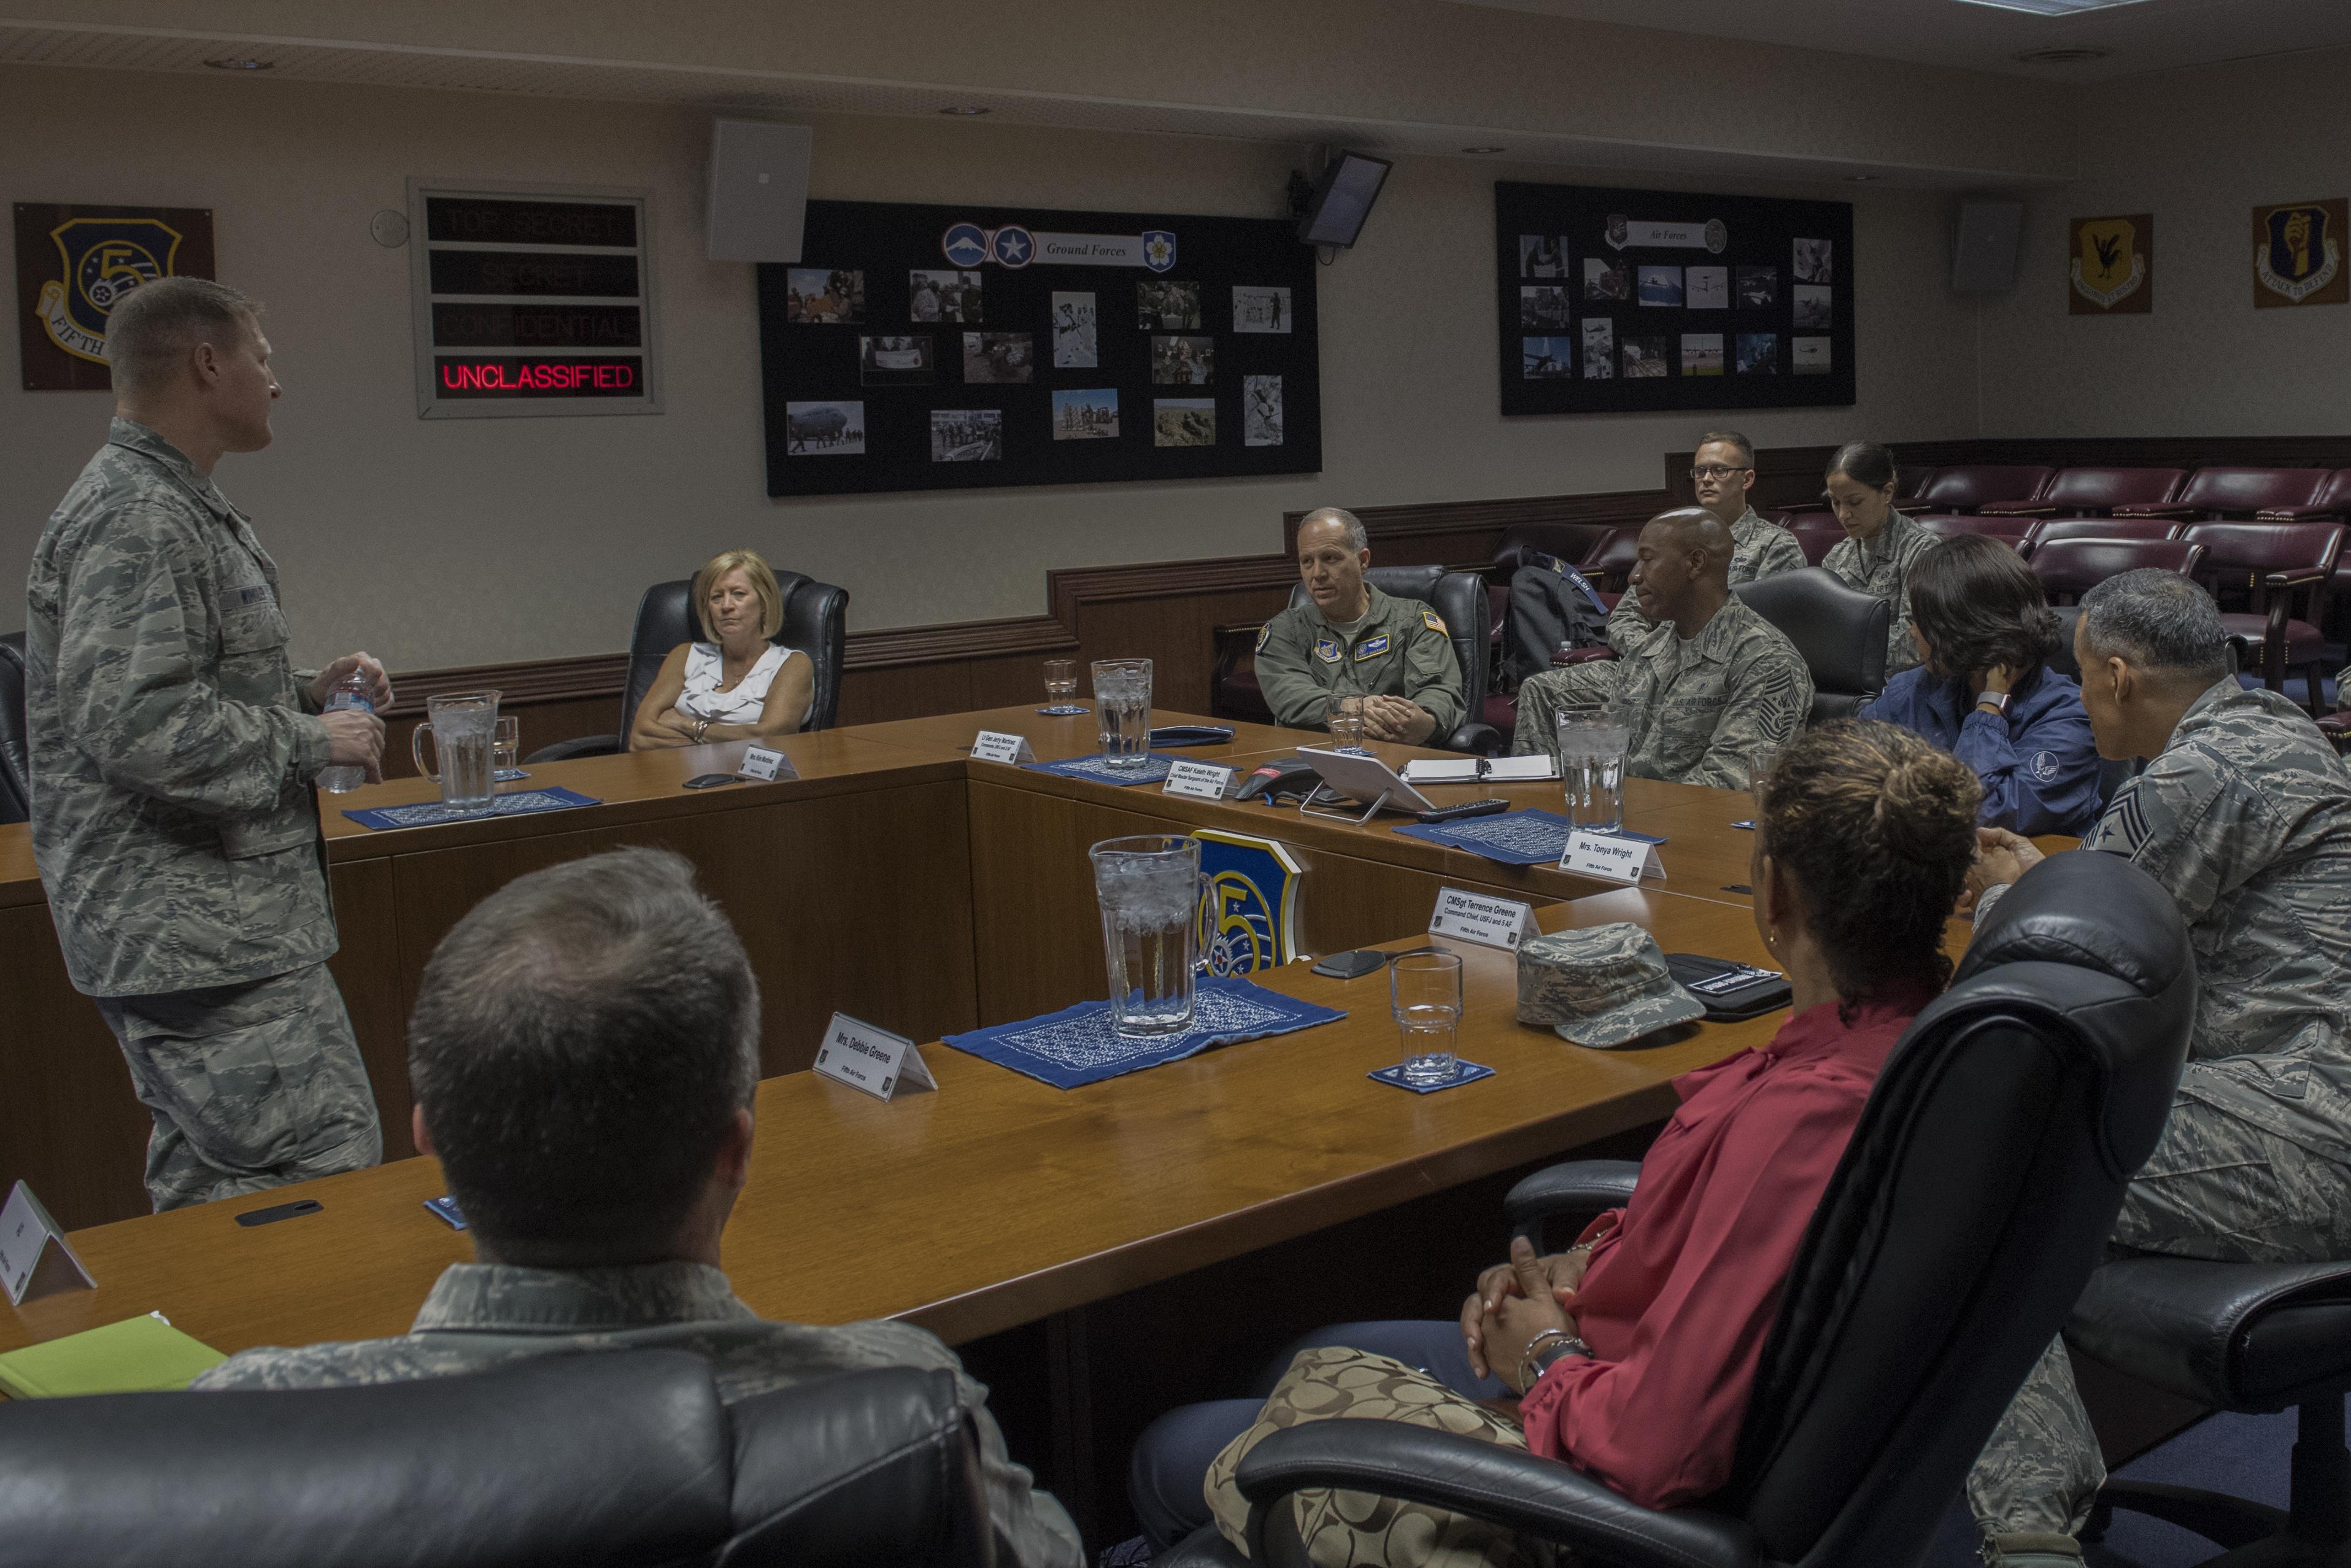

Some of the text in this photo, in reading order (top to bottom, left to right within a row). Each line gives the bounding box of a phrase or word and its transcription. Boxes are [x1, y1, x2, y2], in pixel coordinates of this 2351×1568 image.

[1650, 230, 1687, 240] Air Forces
[1047, 243, 1126, 256] Ground Forces
[2263, 264, 2333, 296] ATTACK TO DEFEND
[52, 316, 104, 355] FIFTH
[443, 365, 633, 389] UNCLASSIFIED
[1570, 572, 1590, 591] WELSH
[1697, 697, 1723, 706] FORCE
[1178, 765, 1193, 774] CMSAF
[1579, 841, 1632, 859] Mrs. Tonya Wright
[1446, 895, 1516, 918] CMSgt Terrence Greene
[1444, 908, 1465, 917] Command
[1467, 912, 1479, 922] Chief,
[1480, 914, 1492, 924] USFJ
[1218, 884, 1260, 973] 5
[835, 1032, 891, 1064] Mrs. Debbie Greene
[841, 1065, 850, 1074] Fifth
[856, 1071, 867, 1081] Force
